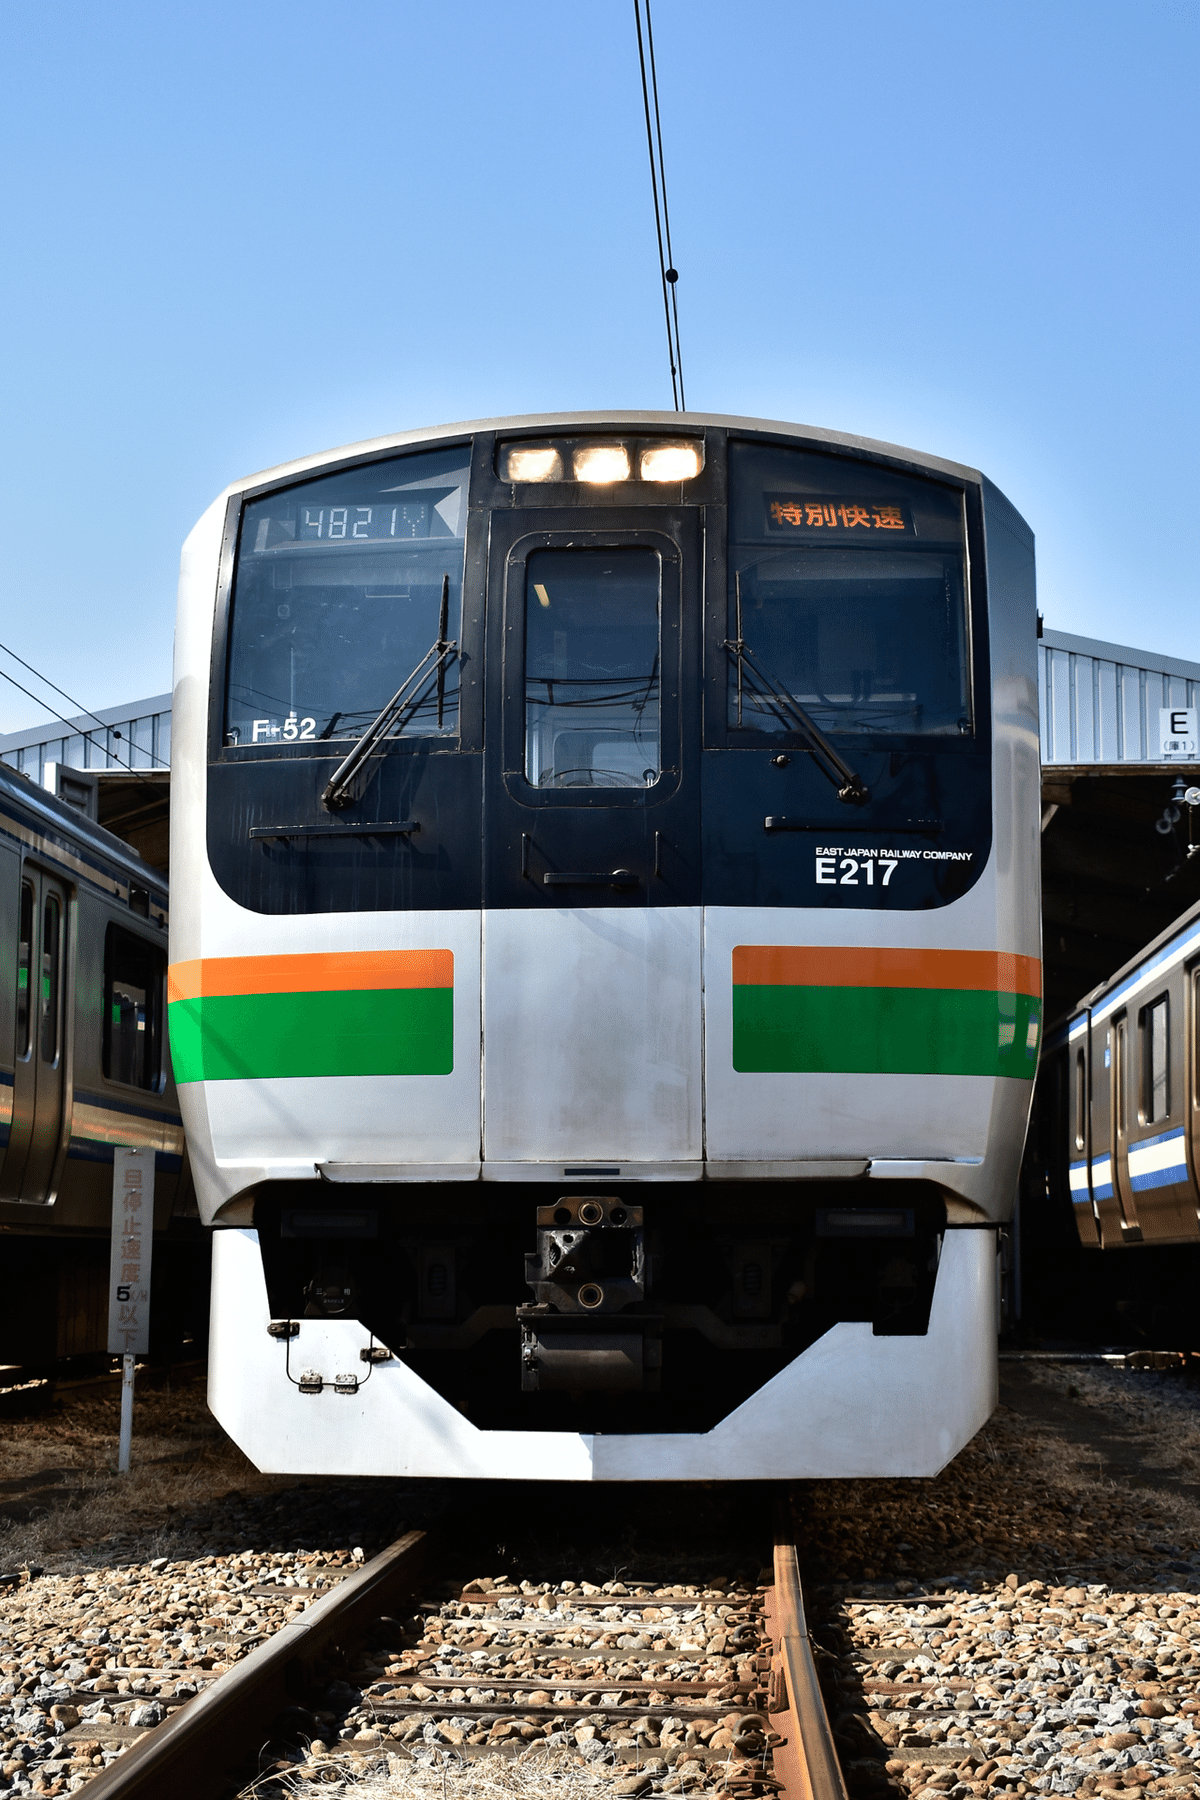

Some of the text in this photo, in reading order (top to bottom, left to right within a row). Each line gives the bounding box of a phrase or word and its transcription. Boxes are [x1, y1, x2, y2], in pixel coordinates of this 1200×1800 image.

[770, 502, 905, 529] 特別快速
[252, 717, 316, 742] F-52
[1170, 711, 1189, 734] E
[815, 847, 973, 860] EAST JAPAN RAILWAY COMPANY
[815, 857, 898, 886] E217
